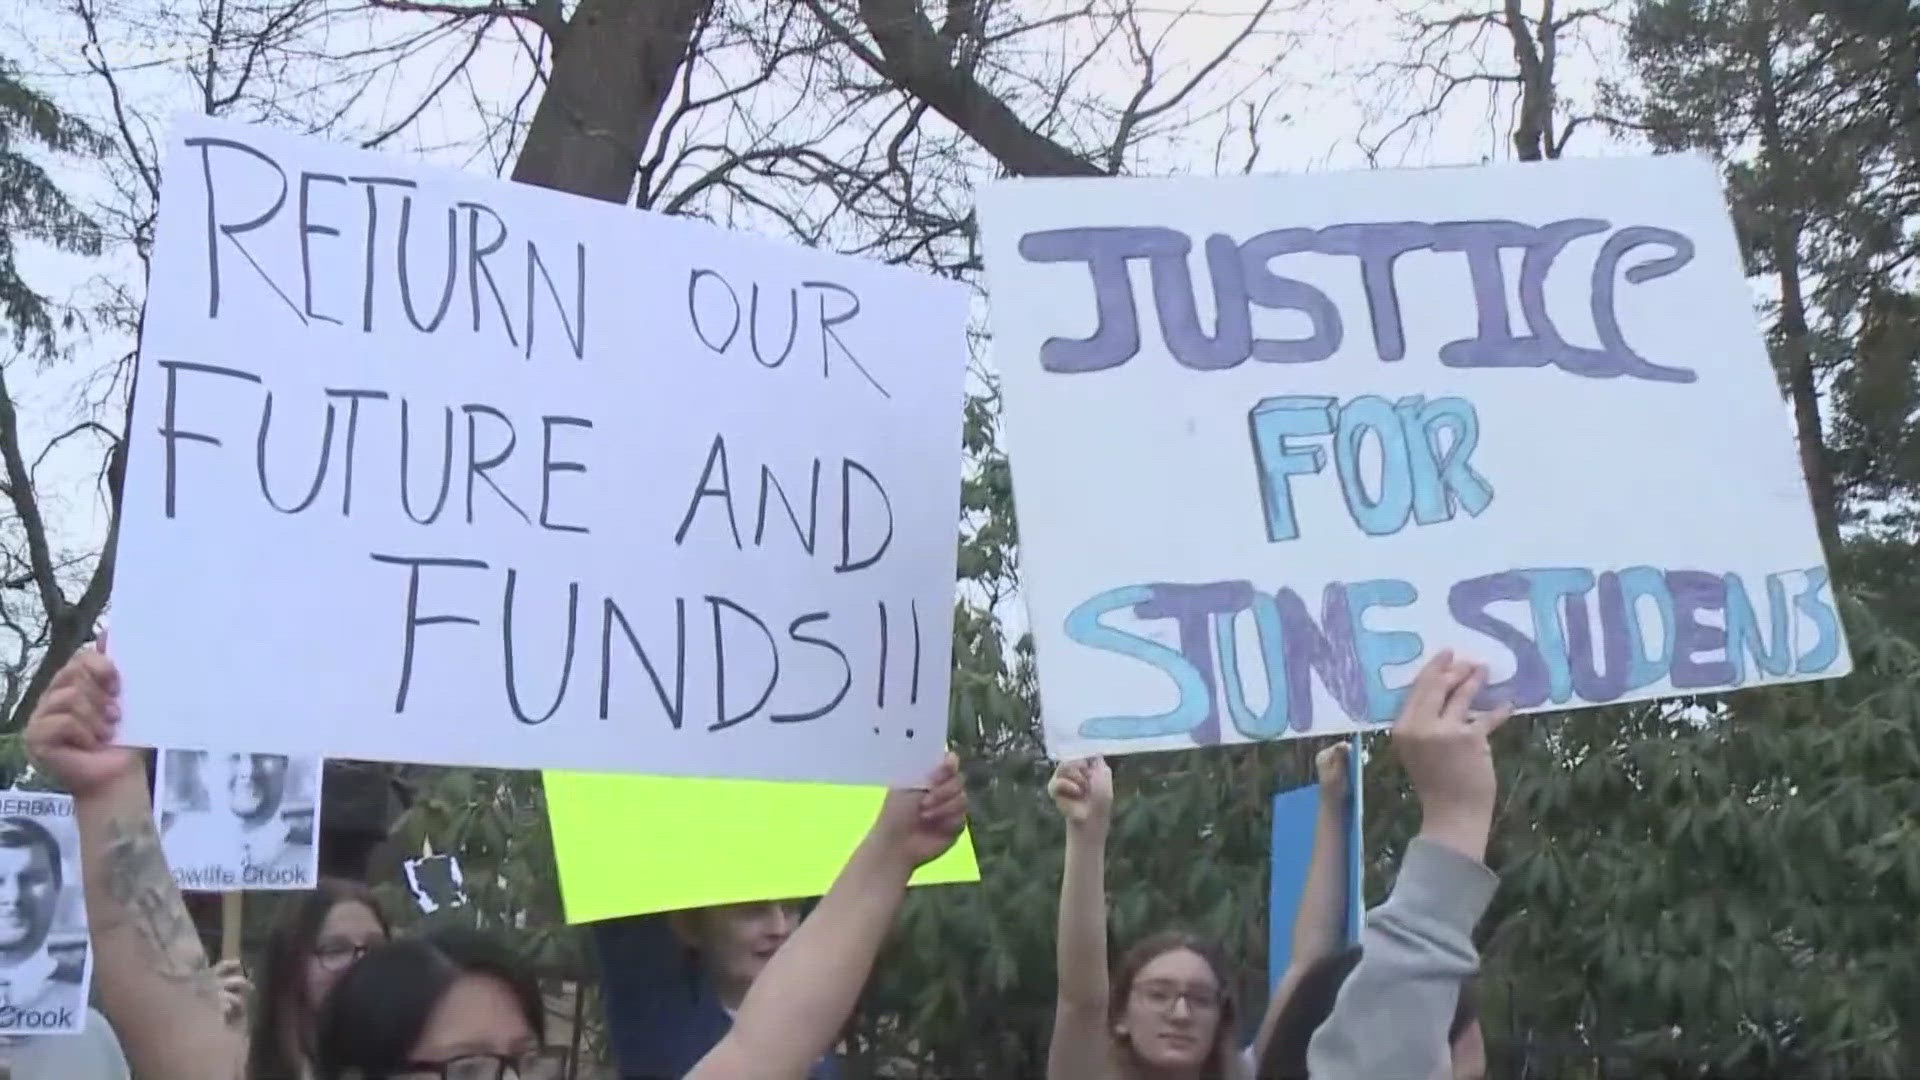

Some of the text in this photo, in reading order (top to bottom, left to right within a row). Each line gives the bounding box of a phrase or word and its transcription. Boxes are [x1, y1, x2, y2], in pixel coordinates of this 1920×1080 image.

[184, 137, 891, 399] RETURN OUR
[1018, 218, 1698, 383] JUSTICE
[158, 360, 894, 573] FUTURE AND
[1248, 395, 1495, 543] FOR
[370, 552, 922, 739] FUNDS!!
[1063, 579, 1424, 745] STONE
[0, 798, 76, 818] ERBAU
[172, 863, 307, 886] owlife Crook
[0, 1005, 73, 1029] Crook
